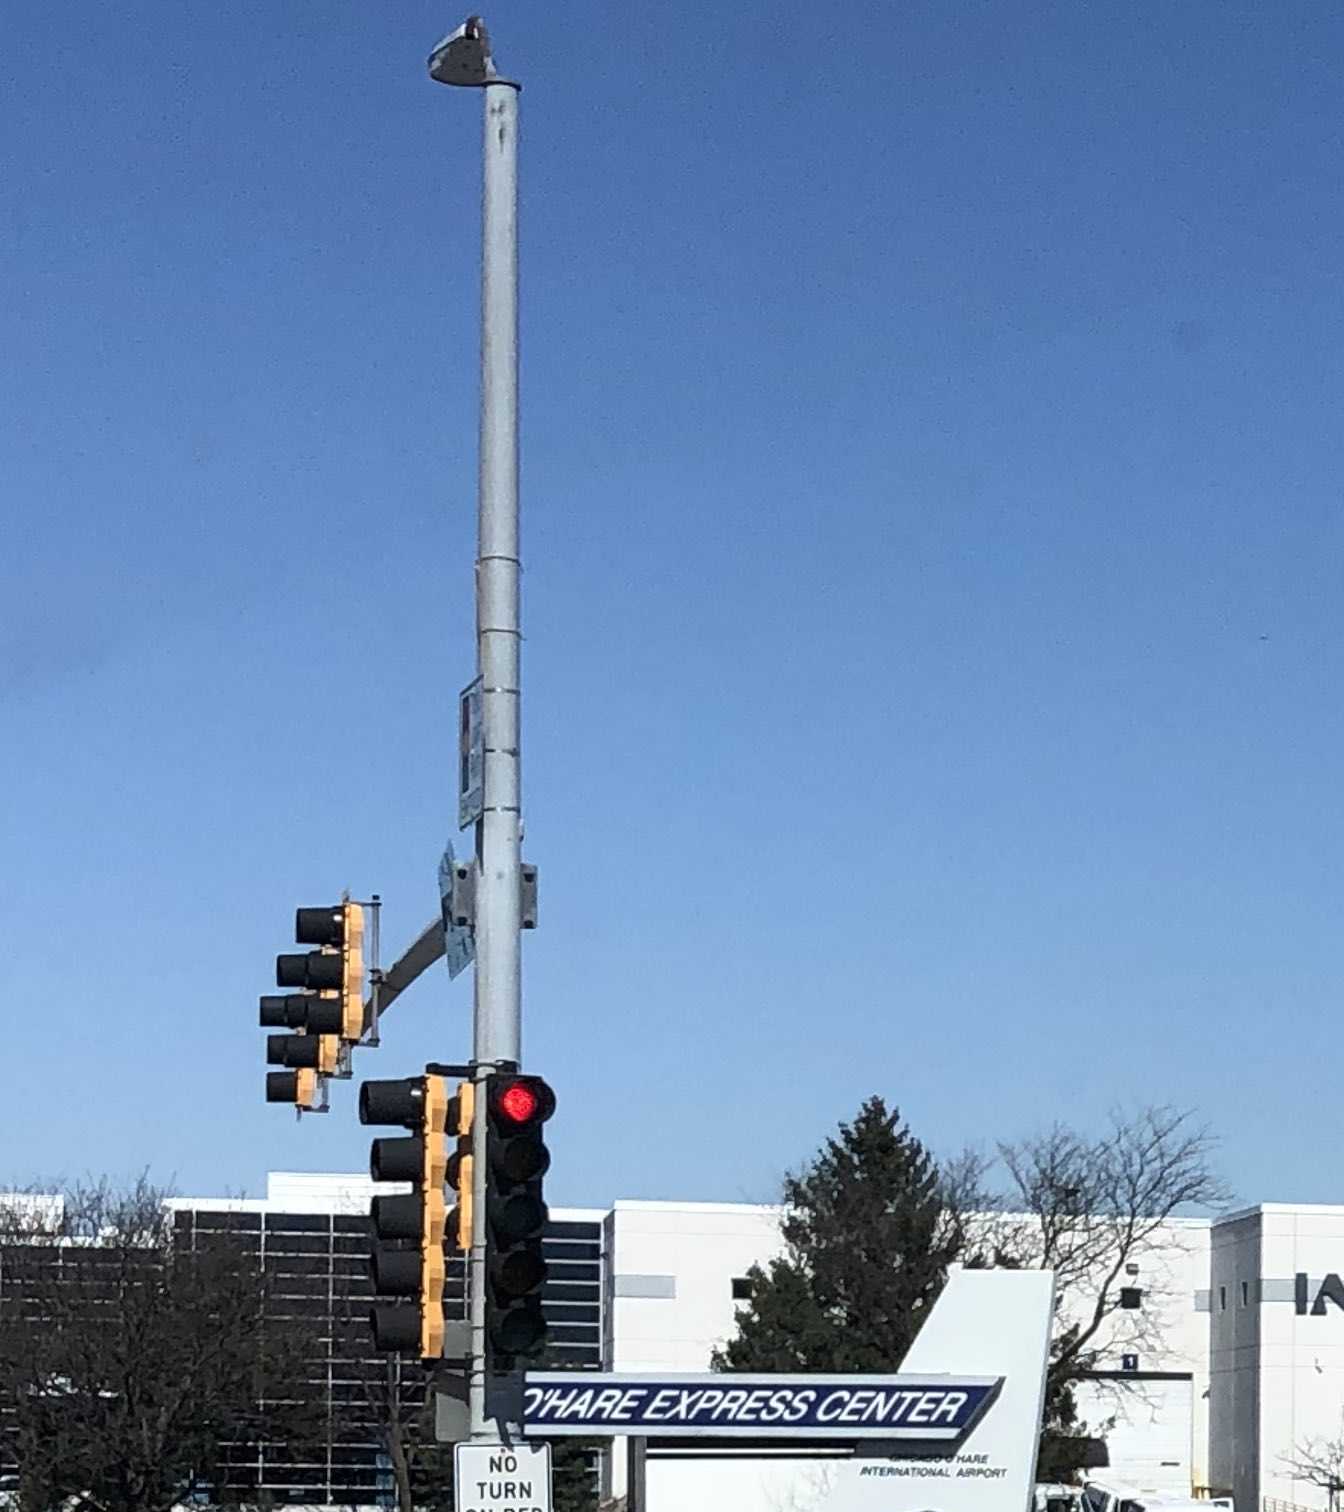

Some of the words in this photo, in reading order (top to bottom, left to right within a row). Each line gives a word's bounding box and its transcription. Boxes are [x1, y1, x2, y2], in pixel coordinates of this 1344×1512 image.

[642, 1389, 817, 1421] EXPRESS
[816, 1391, 968, 1422] CENTER
[489, 1456, 518, 1473] NO
[859, 1466, 951, 1478] INTERNATIONAL
[955, 1467, 1008, 1479] AIRPORT
[476, 1481, 532, 1499] TURN
